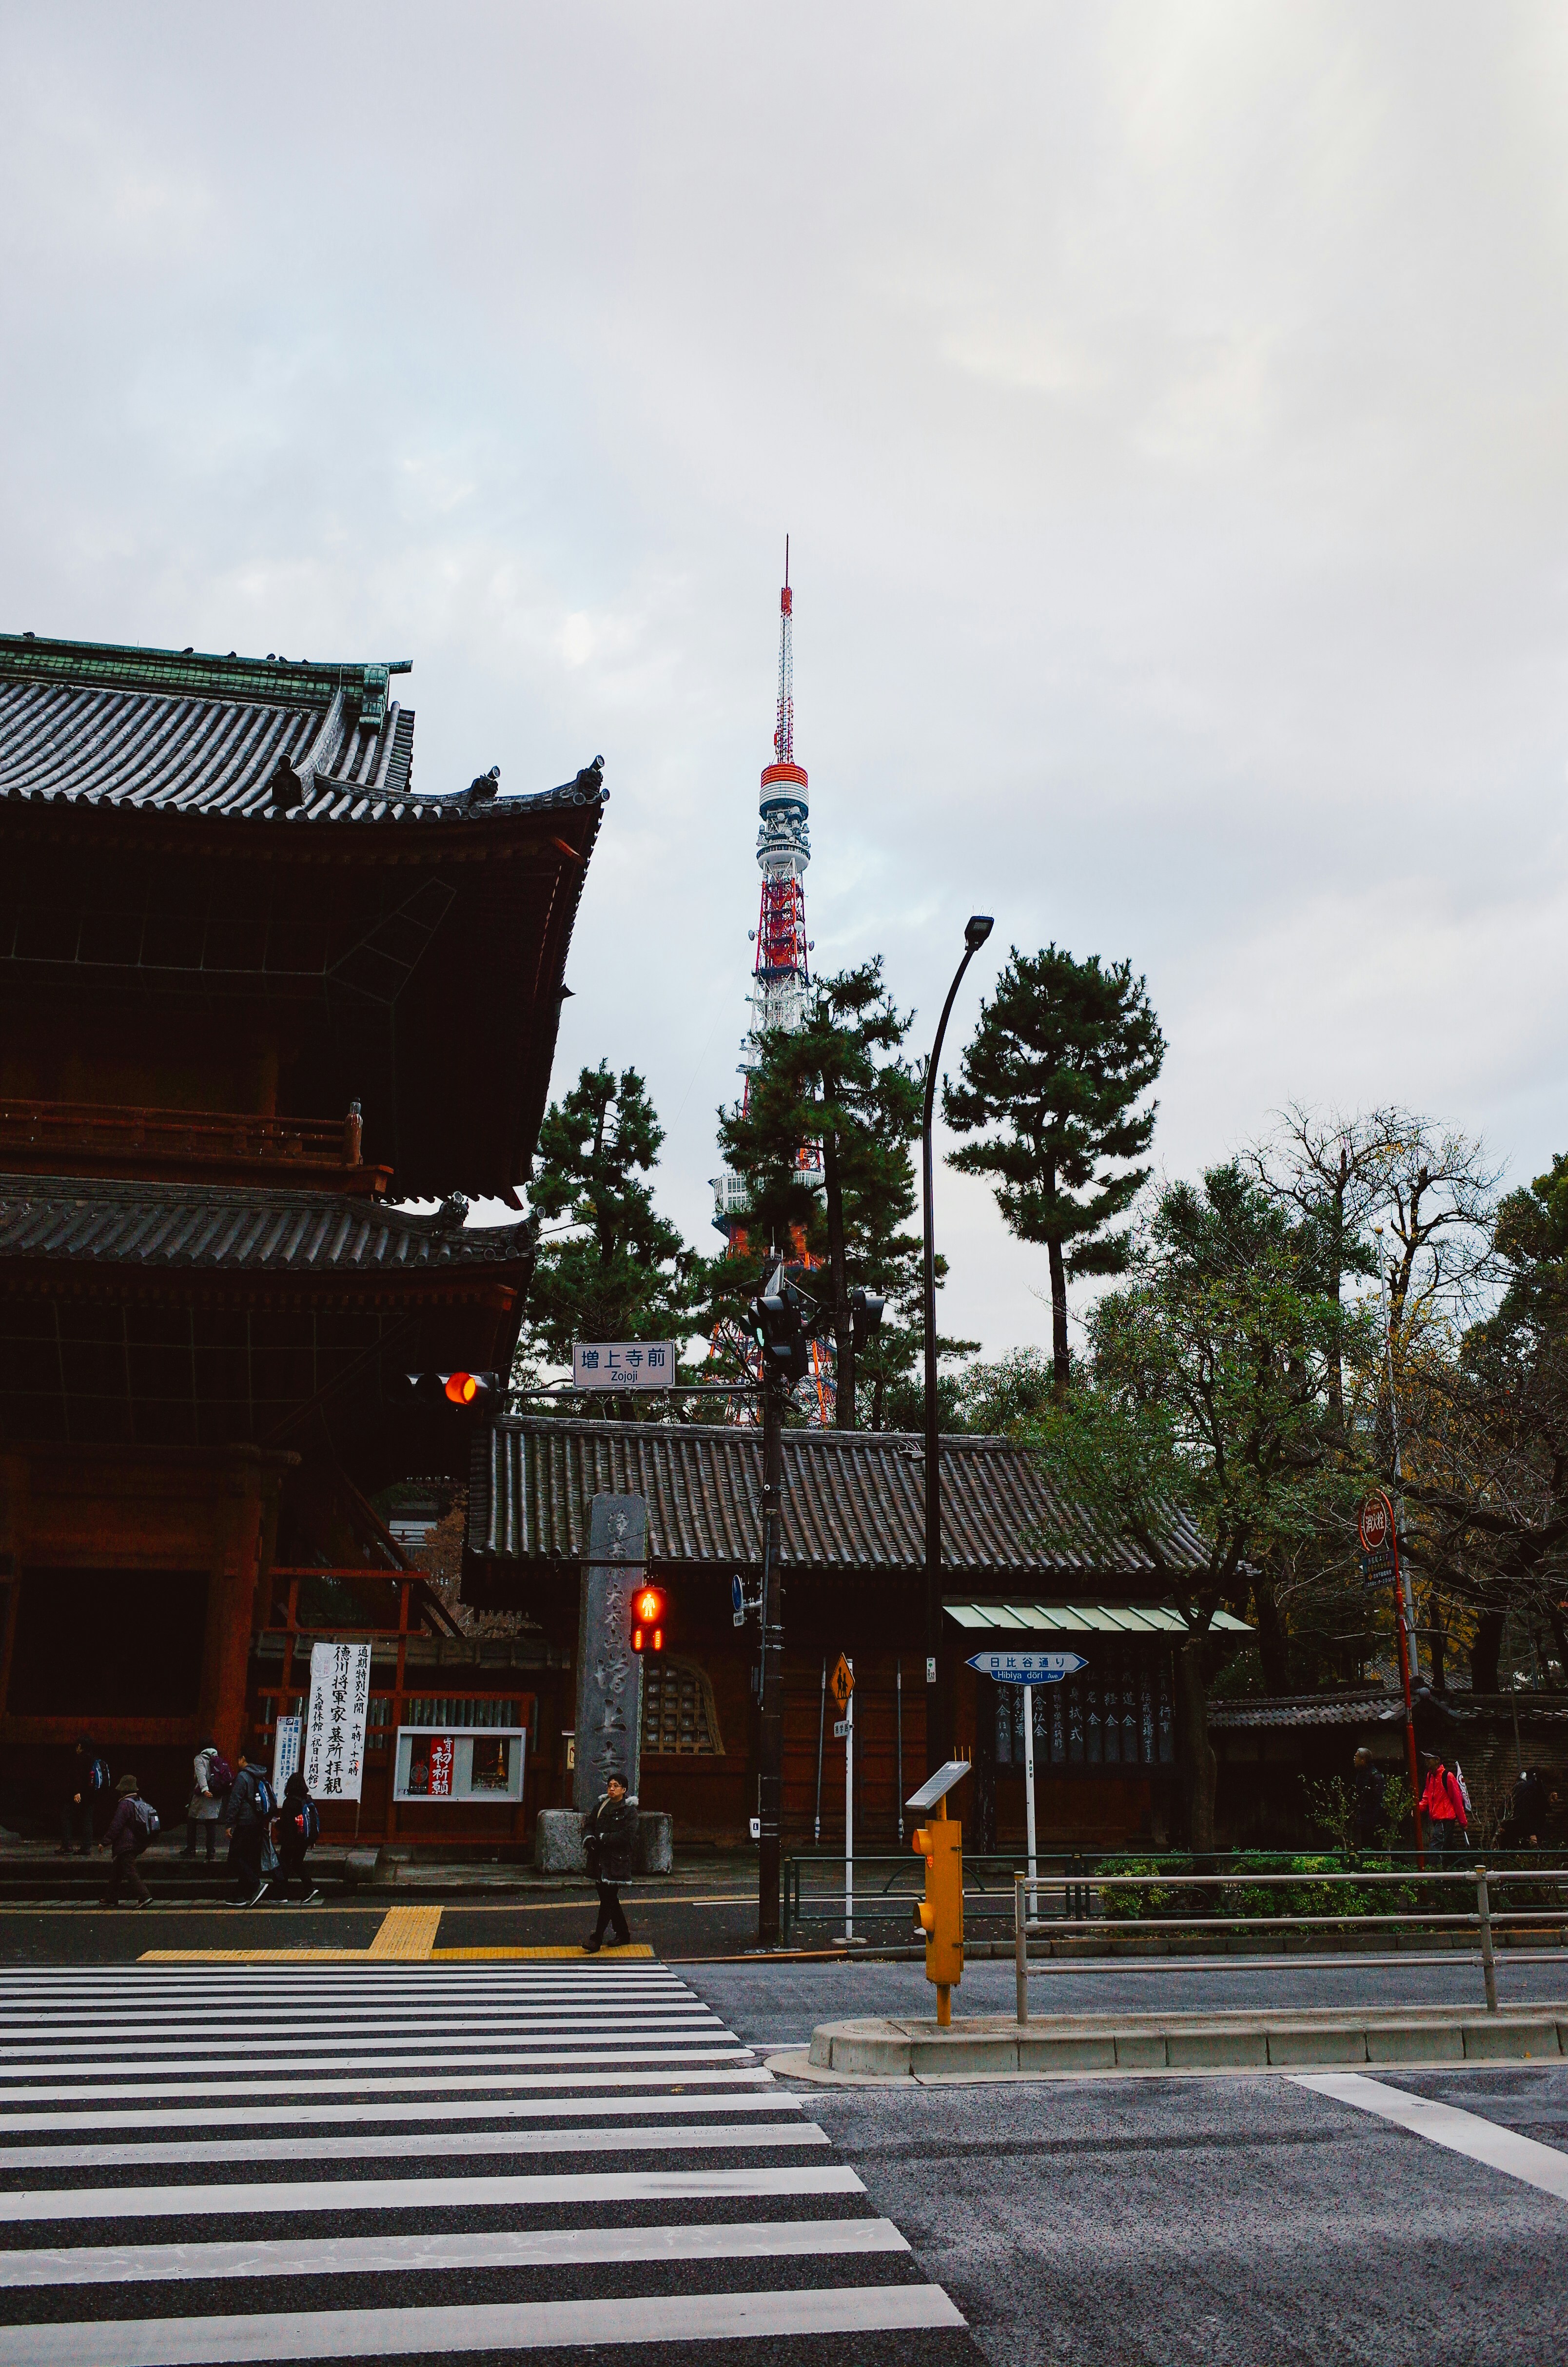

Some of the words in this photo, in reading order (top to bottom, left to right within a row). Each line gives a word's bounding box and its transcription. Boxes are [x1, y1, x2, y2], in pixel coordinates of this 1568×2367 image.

[582, 1348, 666, 1369] 増上寺前
[611, 1370, 638, 1383] Zojoji
[1365, 1510, 1385, 1533] 消火栓
[991, 1658, 1064, 1667] 日比谷通り
[354, 1646, 369, 1714] 通期特別公開
[998, 1671, 1021, 1679] Hibiya
[431, 1746, 452, 1795] 初祈願
